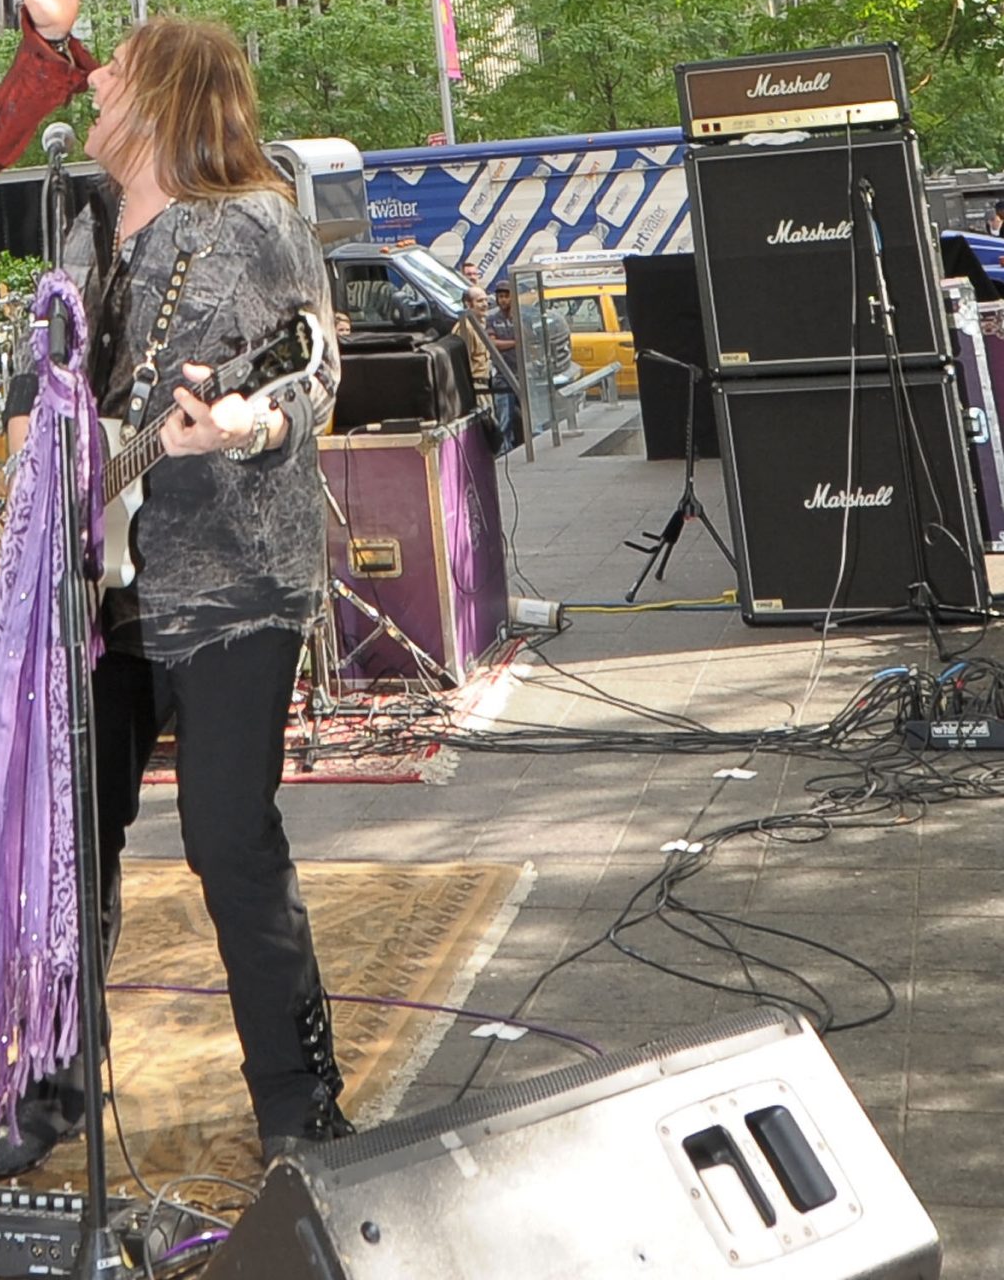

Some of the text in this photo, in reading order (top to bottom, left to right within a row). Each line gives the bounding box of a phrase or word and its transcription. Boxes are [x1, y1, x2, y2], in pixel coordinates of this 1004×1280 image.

[747, 72, 831, 98] Marshall
[766, 219, 853, 245] Marshall
[804, 482, 893, 509] Marshall
